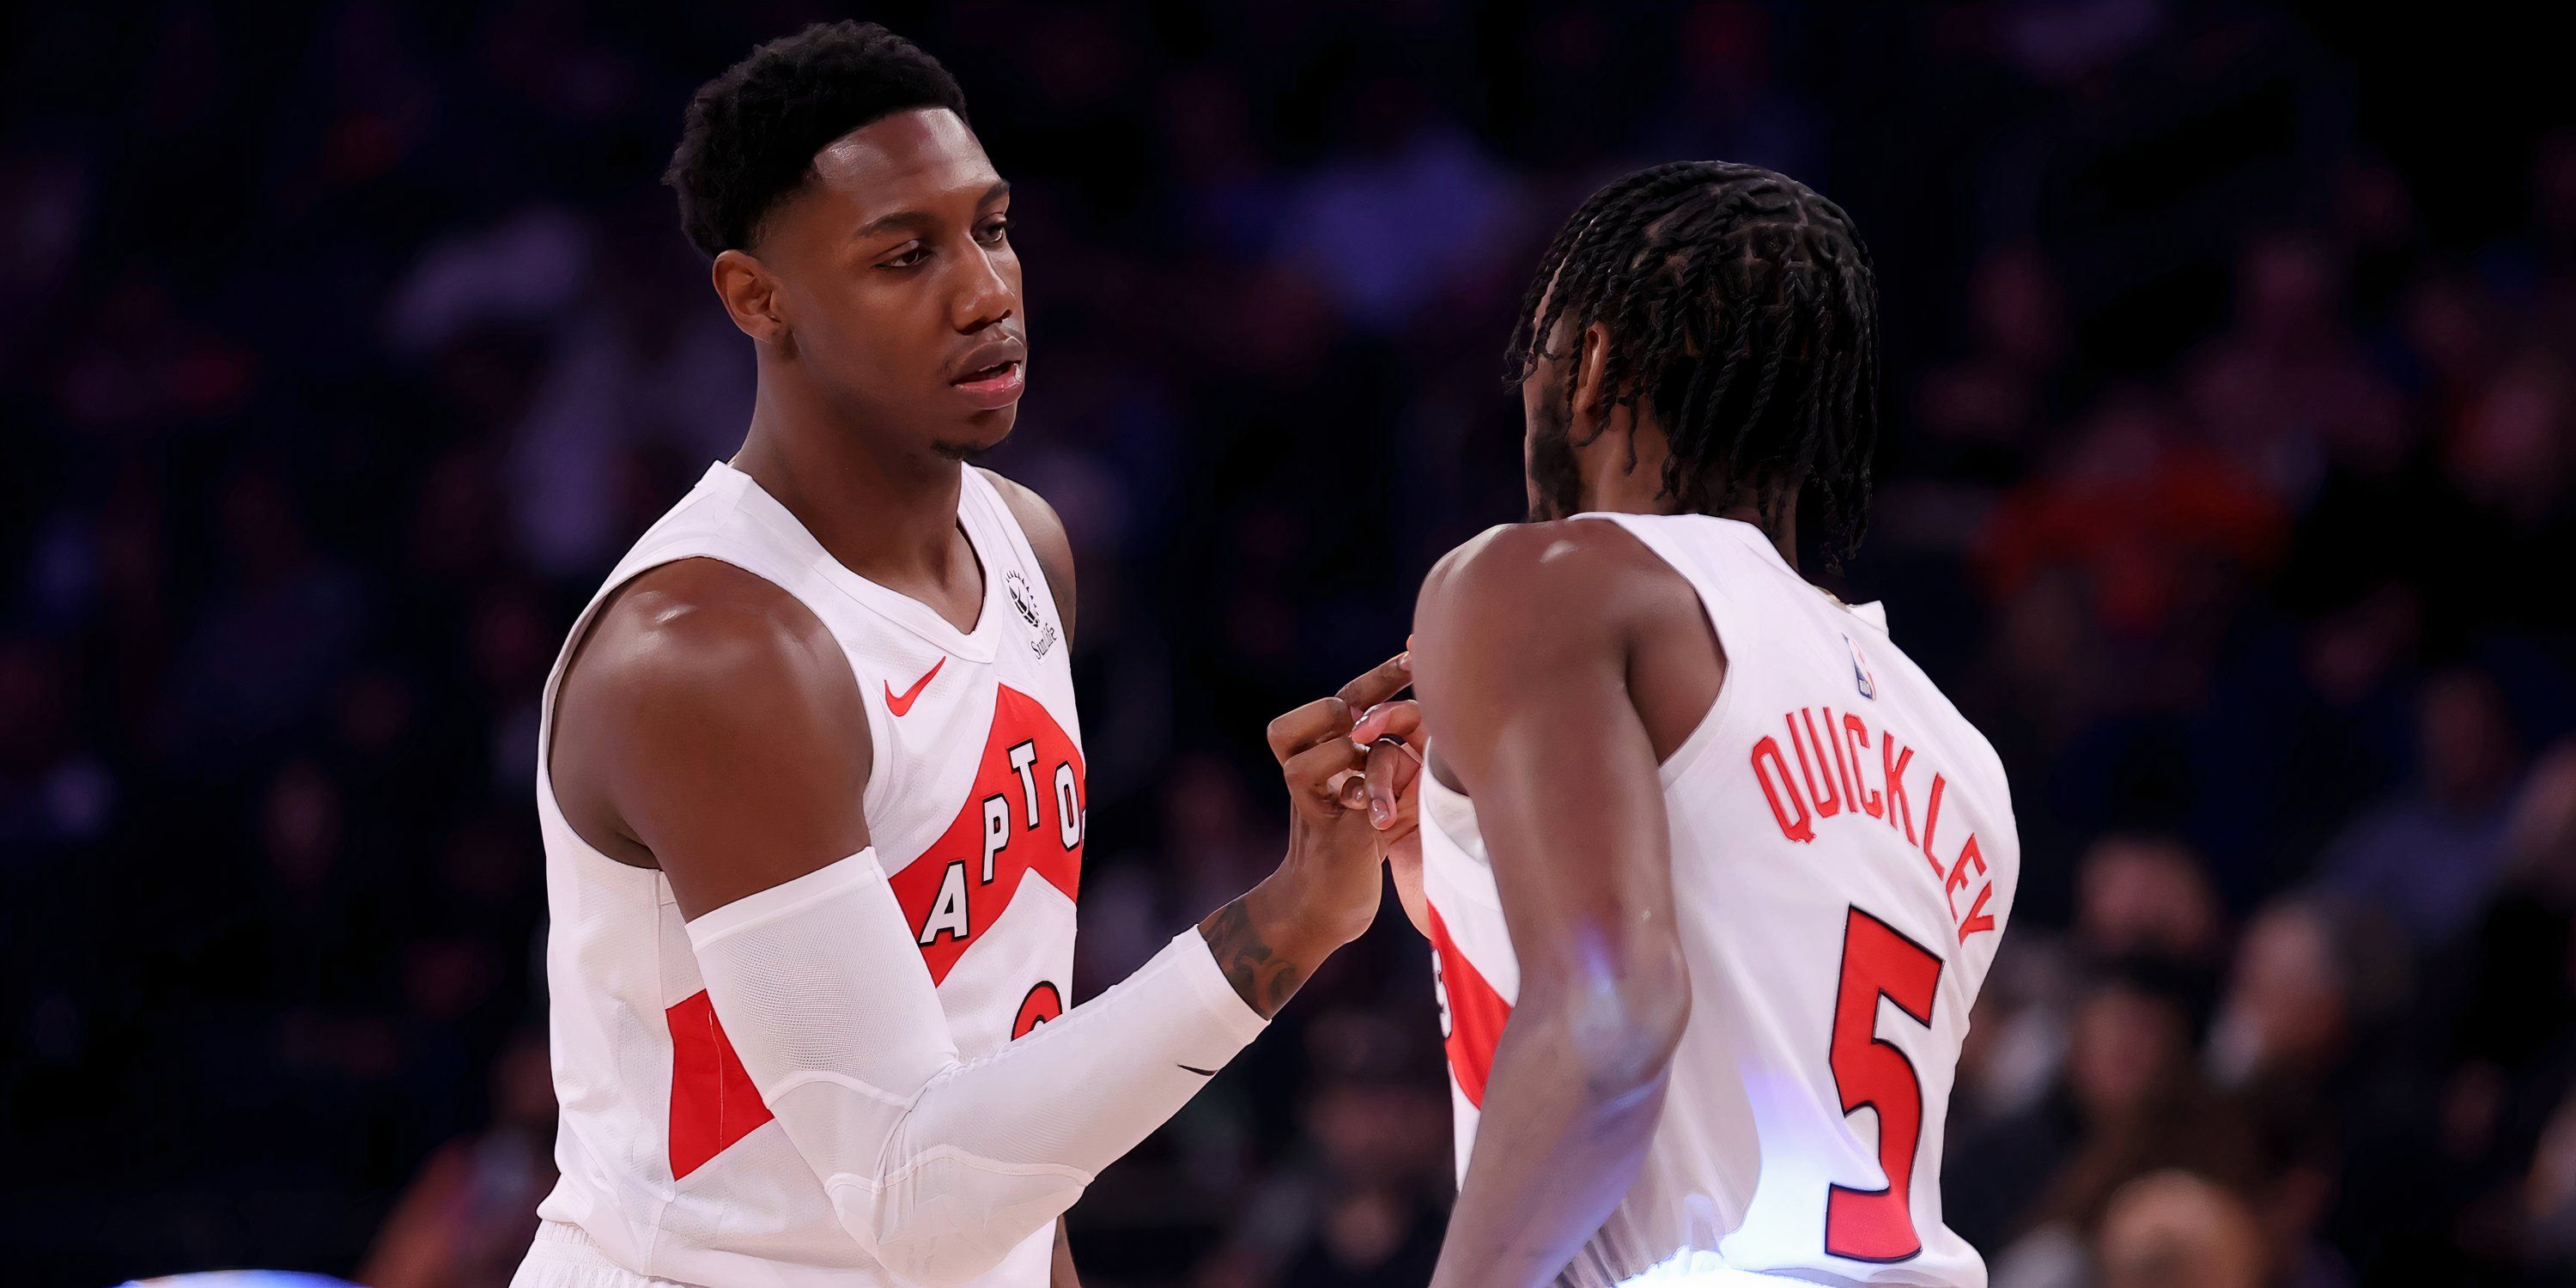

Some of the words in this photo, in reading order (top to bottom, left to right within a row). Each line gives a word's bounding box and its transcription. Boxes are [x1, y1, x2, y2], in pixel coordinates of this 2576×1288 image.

[918, 739, 1086, 946] APTO
[1751, 707, 1996, 950] QUICKLEY
[1825, 902, 1946, 1264] 5
